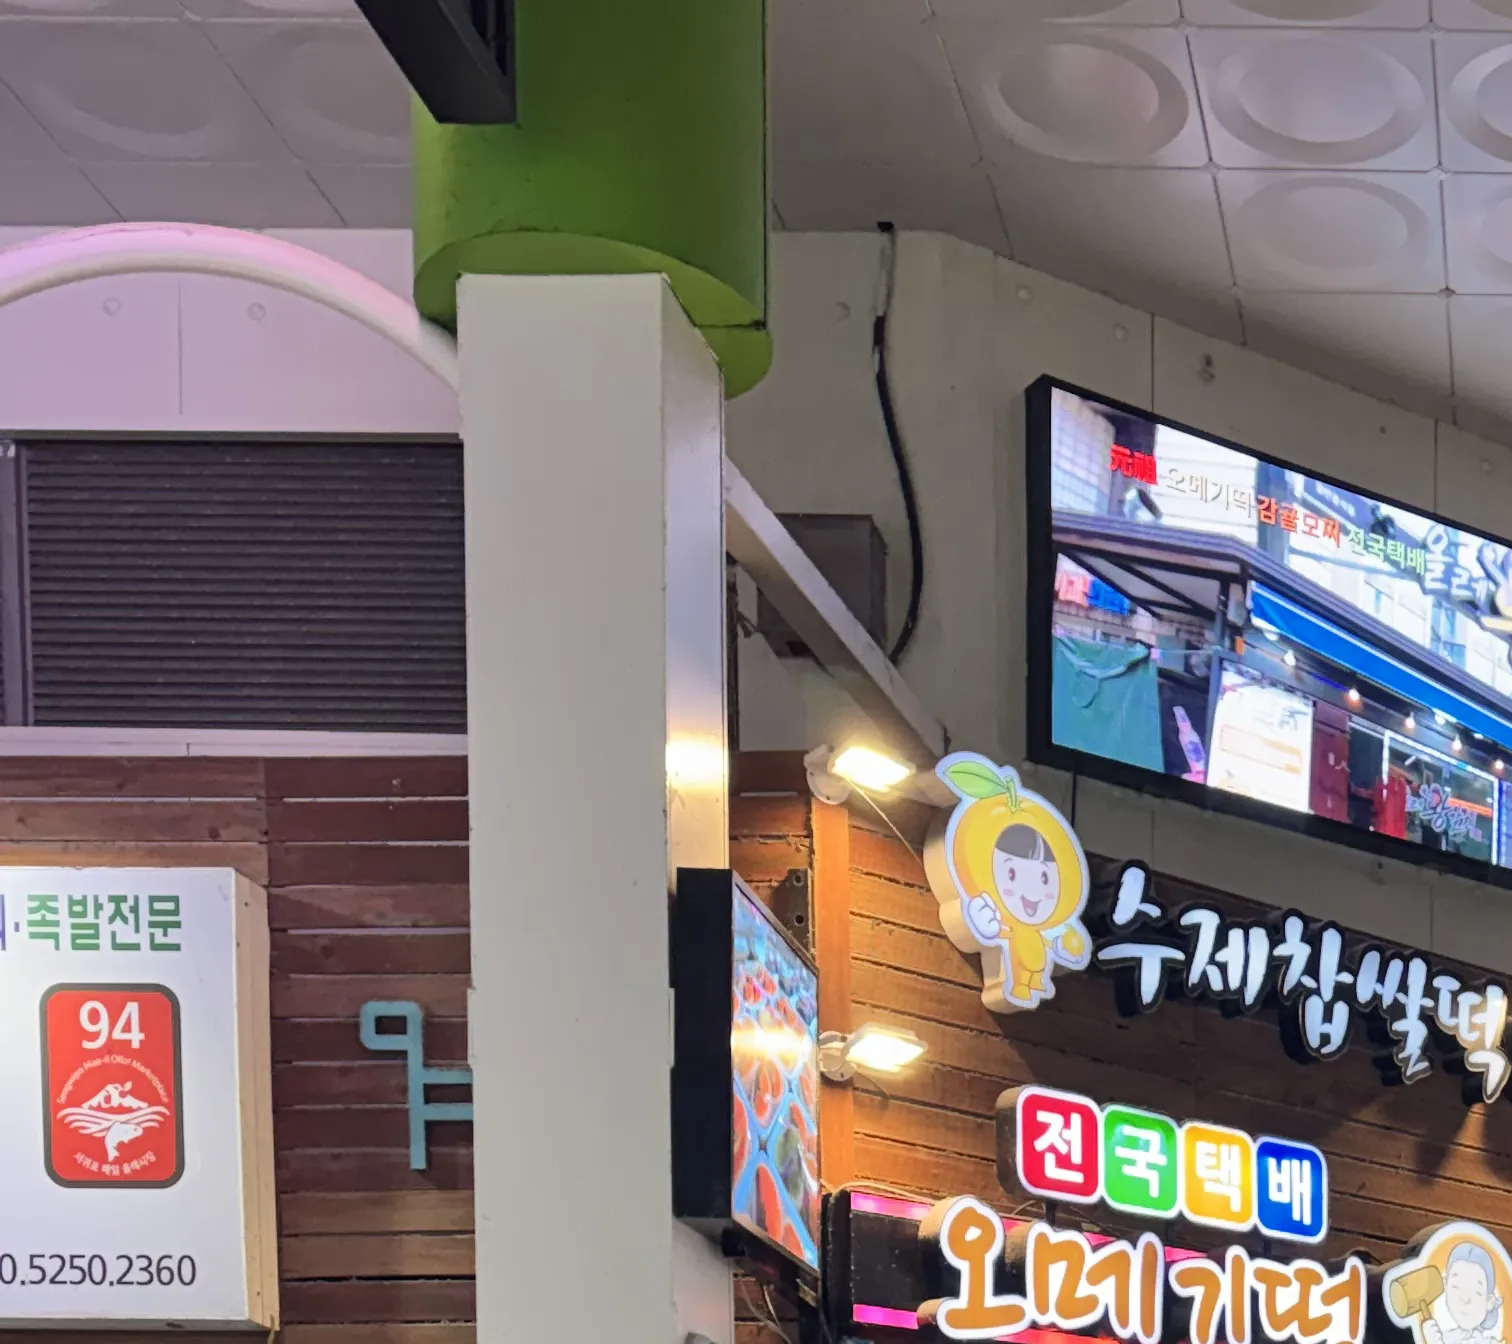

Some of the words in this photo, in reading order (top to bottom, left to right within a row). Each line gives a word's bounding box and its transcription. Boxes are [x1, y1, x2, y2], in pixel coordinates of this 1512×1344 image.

[0, 893, 183, 952] ·족발전문
[79, 1001, 146, 1050] 94
[1098, 865, 1510, 1102] 수제찹쌀떡
[1033, 1108, 1313, 1227] 전국택배
